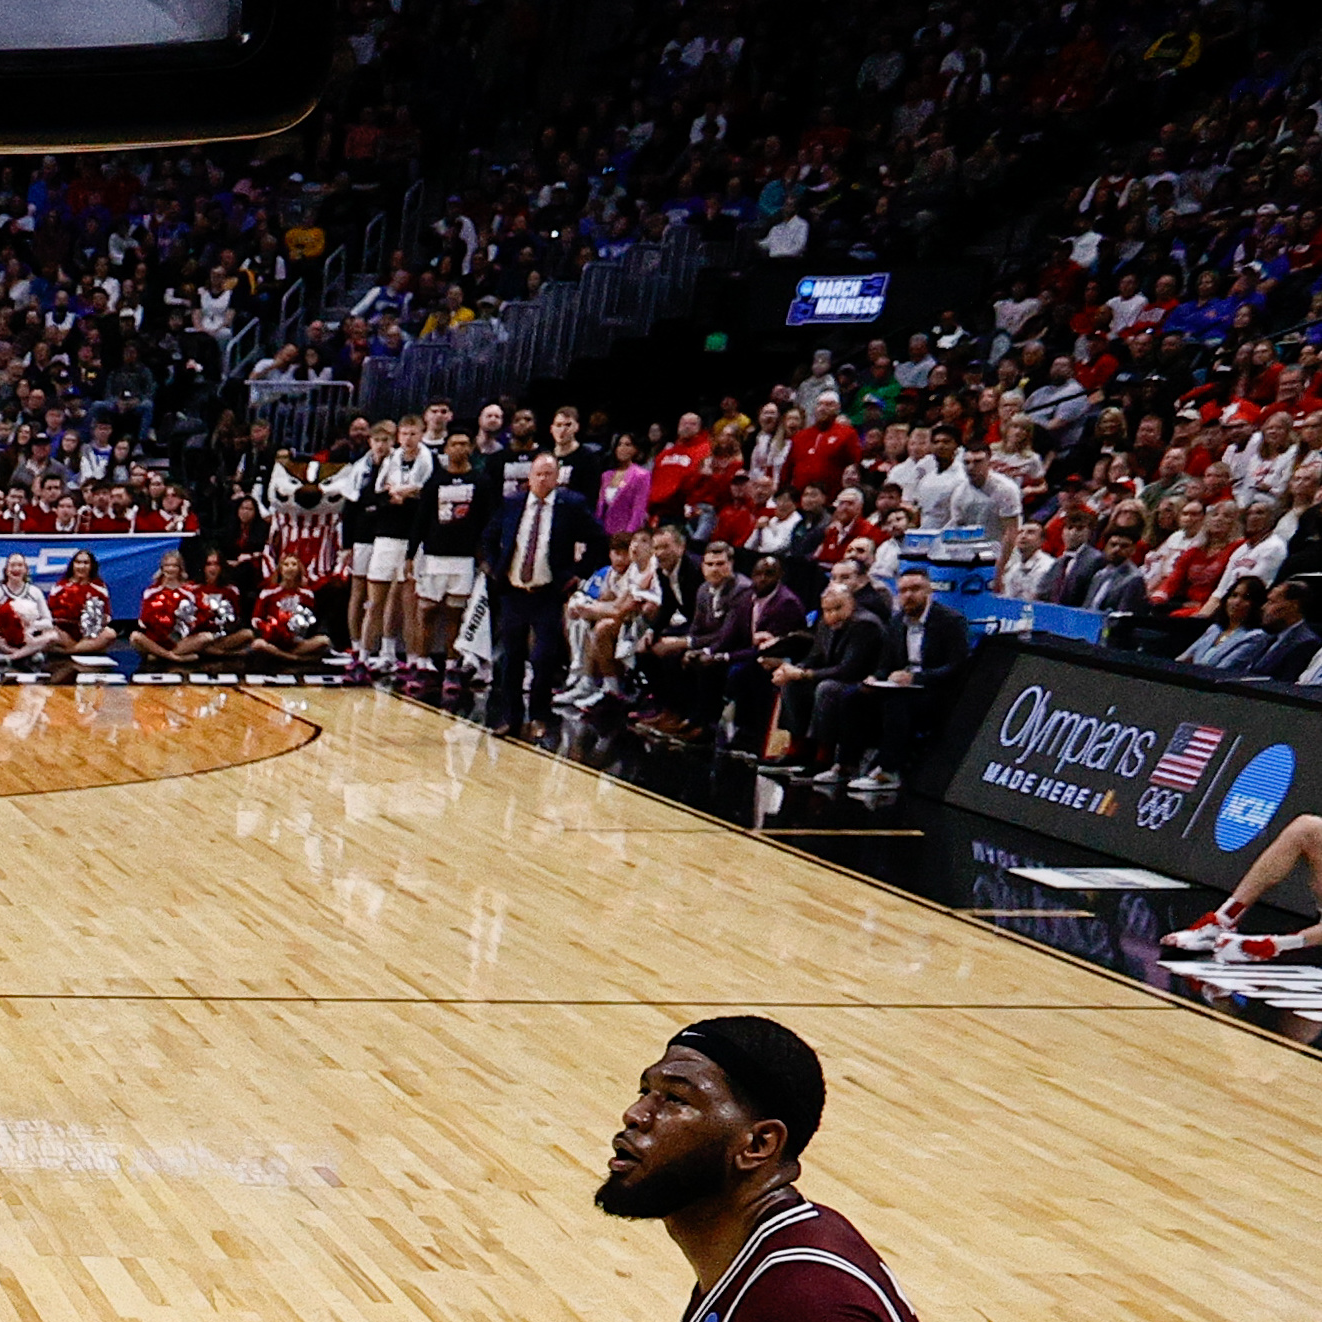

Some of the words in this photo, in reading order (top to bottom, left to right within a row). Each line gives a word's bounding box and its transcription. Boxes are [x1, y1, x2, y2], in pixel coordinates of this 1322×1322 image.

[812, 280, 863, 298] MARCH
[815, 296, 884, 315] MADNESS
[1000, 685, 1157, 778] Olympians
[982, 761, 1039, 794] MADE
[1034, 777, 1091, 809] HERE
